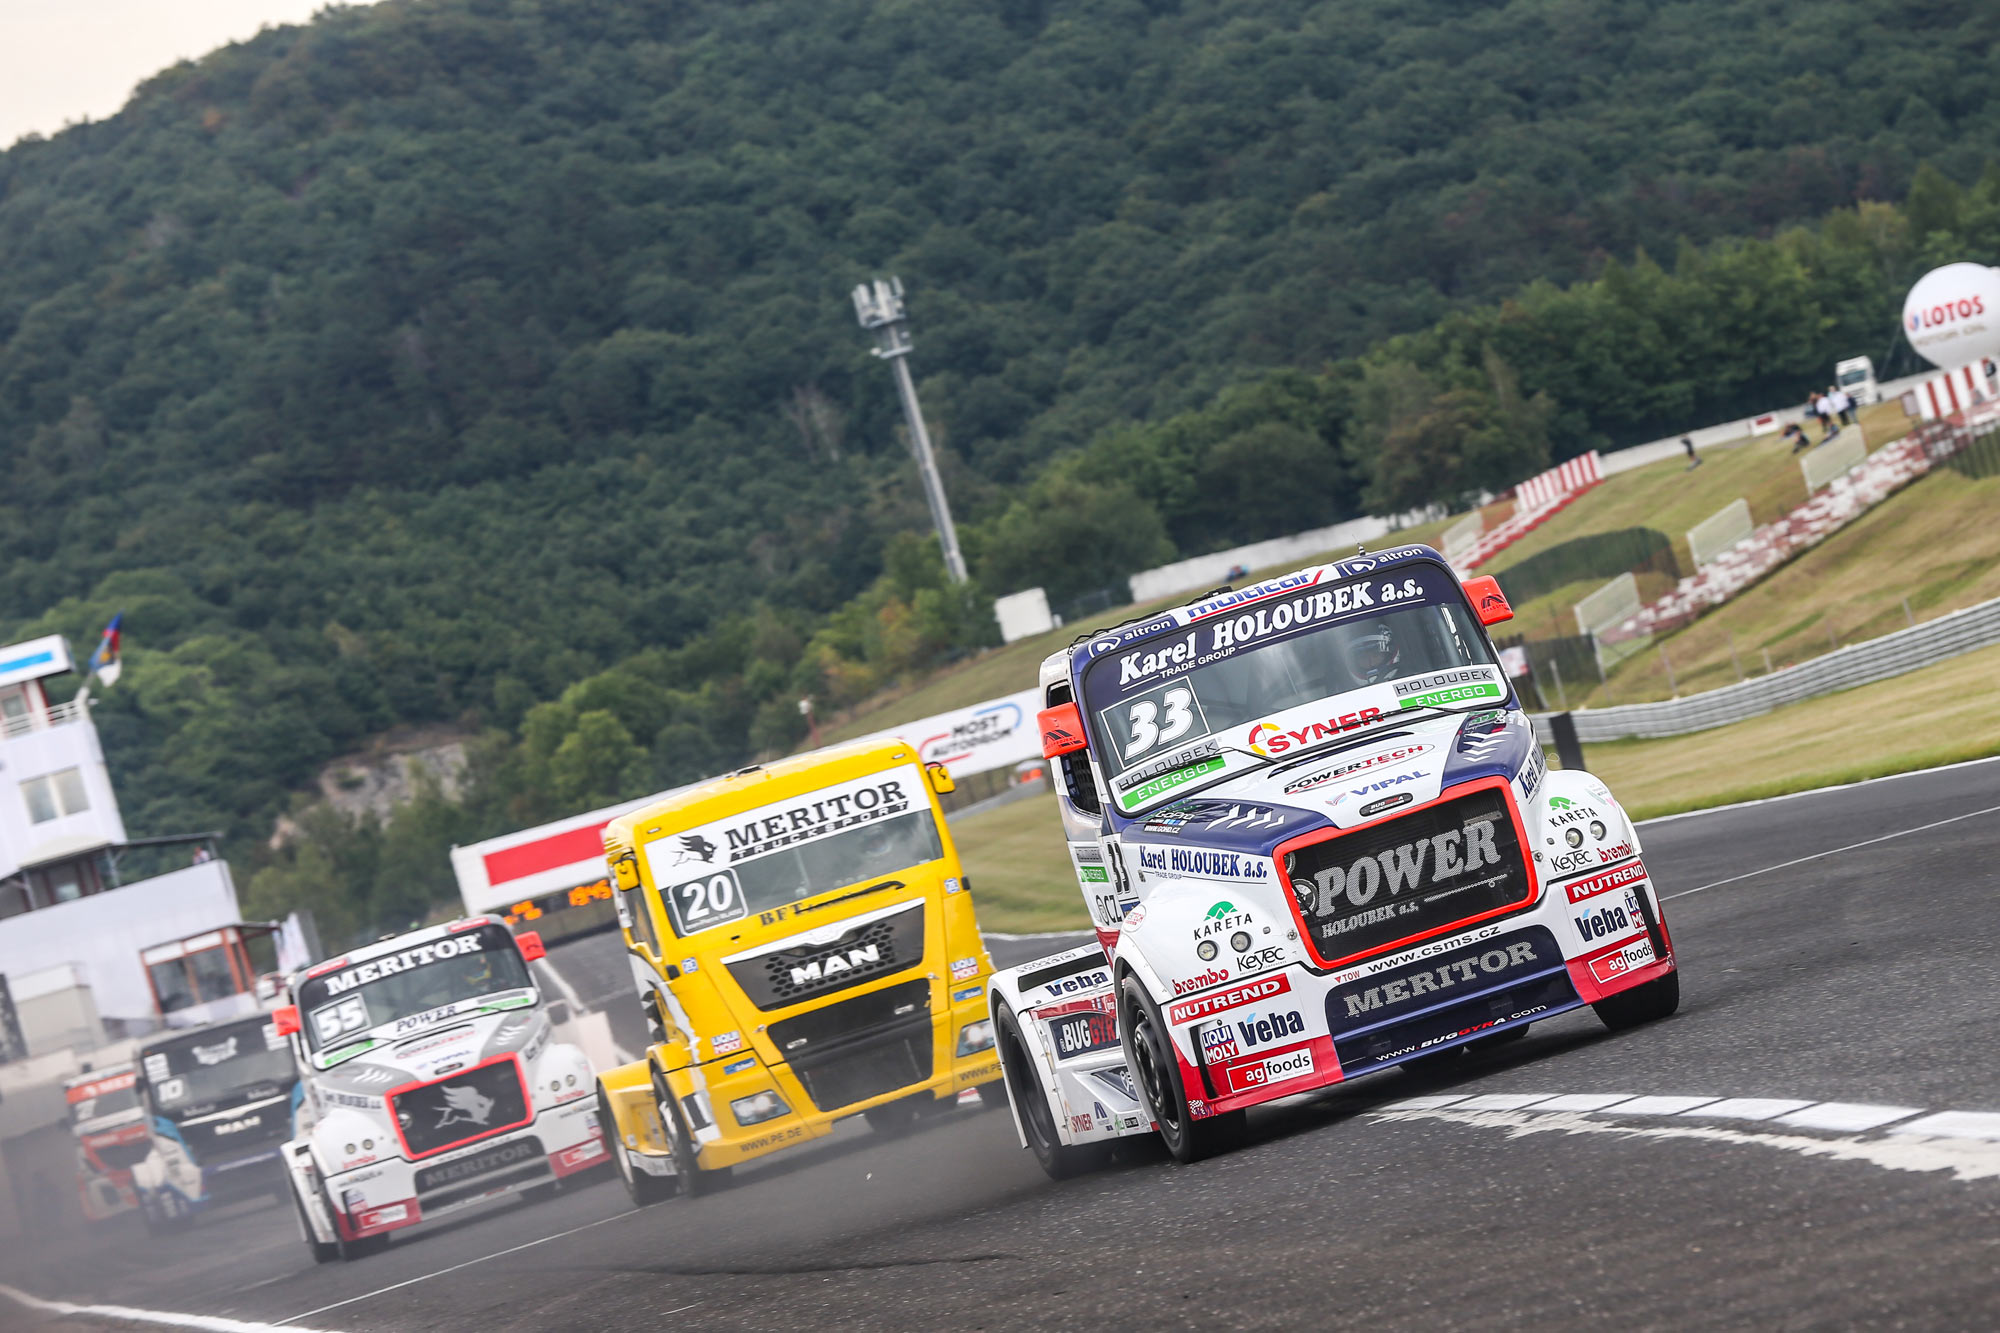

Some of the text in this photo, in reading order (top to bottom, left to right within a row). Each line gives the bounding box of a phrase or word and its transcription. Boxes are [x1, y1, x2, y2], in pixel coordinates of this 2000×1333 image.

[1922, 295, 1984, 328] LOTOS
[1378, 547, 1423, 563] altron
[1187, 573, 1309, 618] multicar
[1119, 578, 1423, 685] Karel HOLOUBEK a.s.
[1124, 620, 1171, 641] altron
[1160, 647, 1235, 679] TRADE GROUP
[1396, 669, 1493, 694] HOLOUBEK
[1416, 686, 1486, 706] ENERGO
[952, 715, 1000, 736] MOST
[1124, 688, 1194, 760] 33
[1267, 707, 1384, 753] SYNER
[1118, 742, 1218, 790] HOLOUBEK
[1137, 762, 1209, 800] ENERGO
[1284, 745, 1424, 794] POWERTECH
[1350, 770, 1431, 796] VIPAL
[724, 781, 906, 850] MERITOR
[736, 801, 907, 859] TRUCKSPORT
[1549, 807, 1599, 828] KARETA
[1106, 841, 1130, 895] 33
[1139, 845, 1268, 879] Karel HOLOUBEK a.s.
[1314, 820, 1501, 918] POWER
[1550, 850, 1592, 872] KeyTec
[682, 874, 733, 921] 20
[1572, 864, 1644, 899] NUTREND
[1193, 913, 1253, 941] KARETA
[1322, 901, 1419, 938] HOLOUBEK a.s.
[324, 935, 482, 996] MERITOR
[790, 944, 880, 985] MAN
[950, 957, 977, 972] LIQUI
[1236, 946, 1285, 972] KeyTec
[1368, 926, 1501, 973] www.csms.cz
[953, 965, 979, 980] MOLY
[1172, 968, 1229, 995] brembo
[1343, 970, 1360, 981] TOW
[1343, 941, 1537, 1017] MERITOR
[1174, 980, 1281, 1021] NUTREND
[316, 1000, 365, 1041] 55
[396, 1005, 457, 1032] POWER
[1376, 1004, 1547, 1061] www.BUGGYRA.com
[1202, 1025, 1232, 1047] LIQUI
[1206, 1041, 1236, 1064] MOLY
[158, 1079, 184, 1102] 10
[740, 1127, 803, 1152] WWW.PE.DE
[1071, 1113, 1094, 1133] SYNER
[425, 1143, 532, 1187] MERITOR
